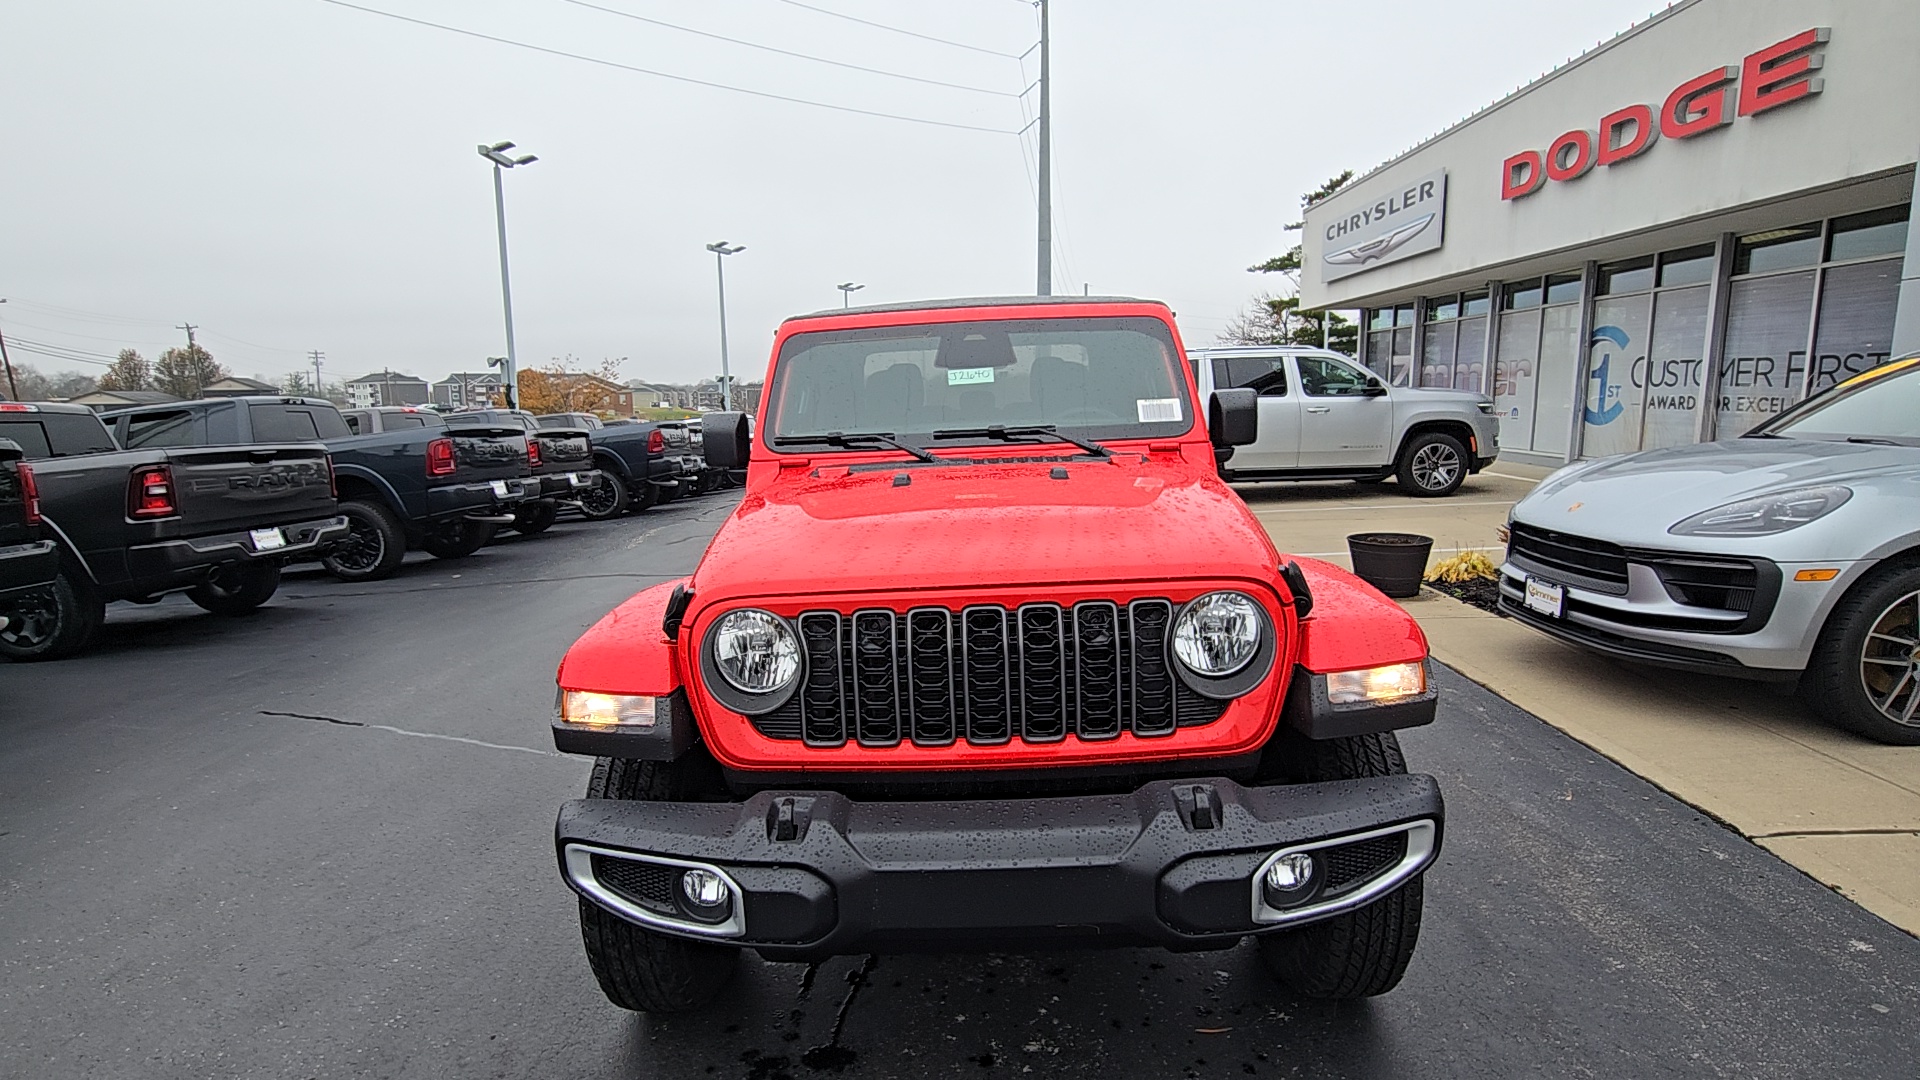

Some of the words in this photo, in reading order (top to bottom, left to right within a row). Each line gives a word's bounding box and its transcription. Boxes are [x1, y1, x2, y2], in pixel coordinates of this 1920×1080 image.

[1501, 26, 1831, 200] DODGE
[1326, 180, 1435, 241] CHRYSLER
[1647, 395, 1696, 411] AWARD
[228, 471, 299, 491] RAM
